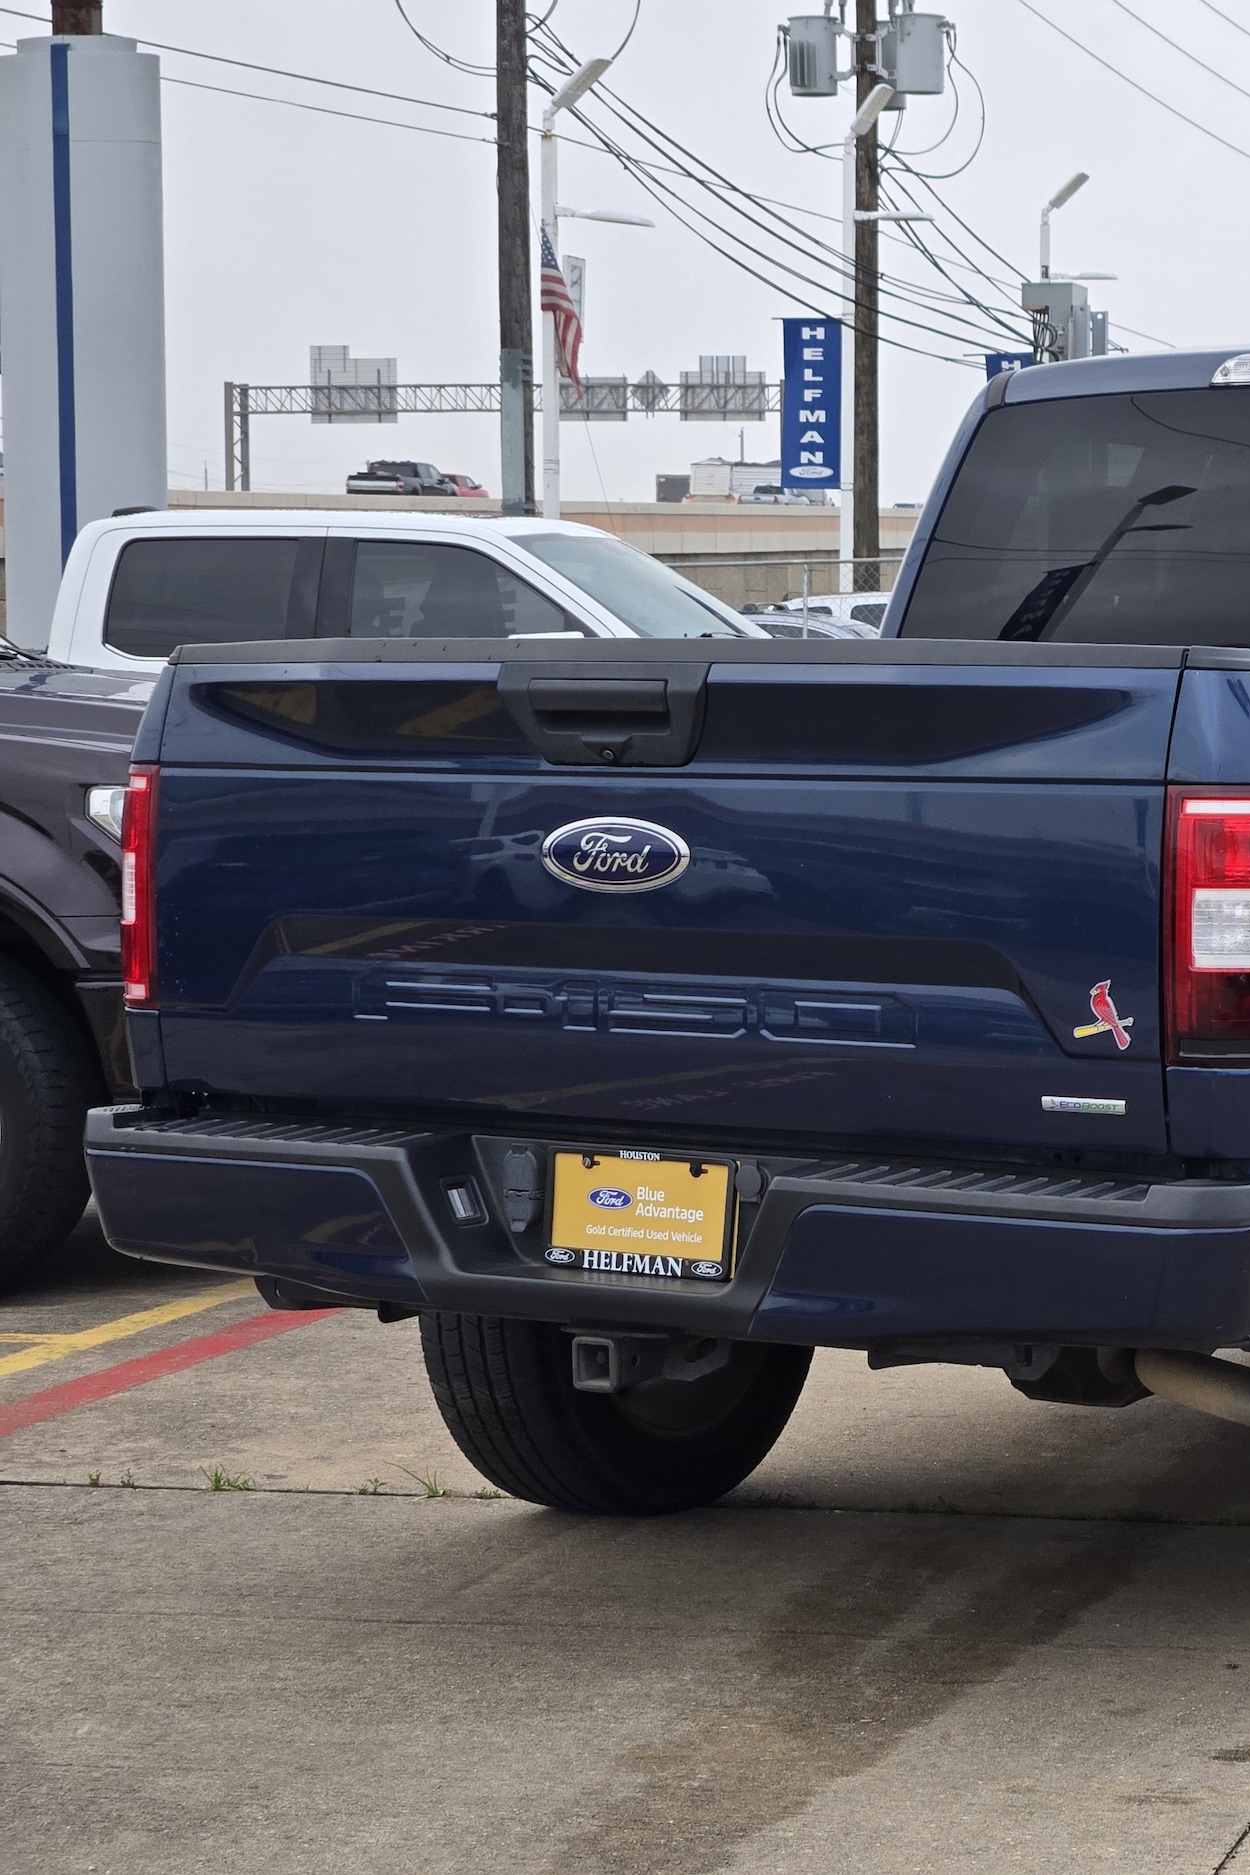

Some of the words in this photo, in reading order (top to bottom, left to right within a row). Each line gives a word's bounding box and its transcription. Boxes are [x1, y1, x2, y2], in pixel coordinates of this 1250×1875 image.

[799, 326, 827, 465] HELFMAN
[572, 831, 652, 874] Ford
[619, 1149, 661, 1161] HOUSTON
[636, 1186, 665, 1202] Blue
[635, 1203, 704, 1223] Advantage
[585, 1224, 606, 1236] Gold
[607, 1225, 644, 1240] Certified
[646, 1229, 669, 1241] Used
[671, 1231, 703, 1244] Vehicle
[581, 1249, 683, 1278] HELFMAN
